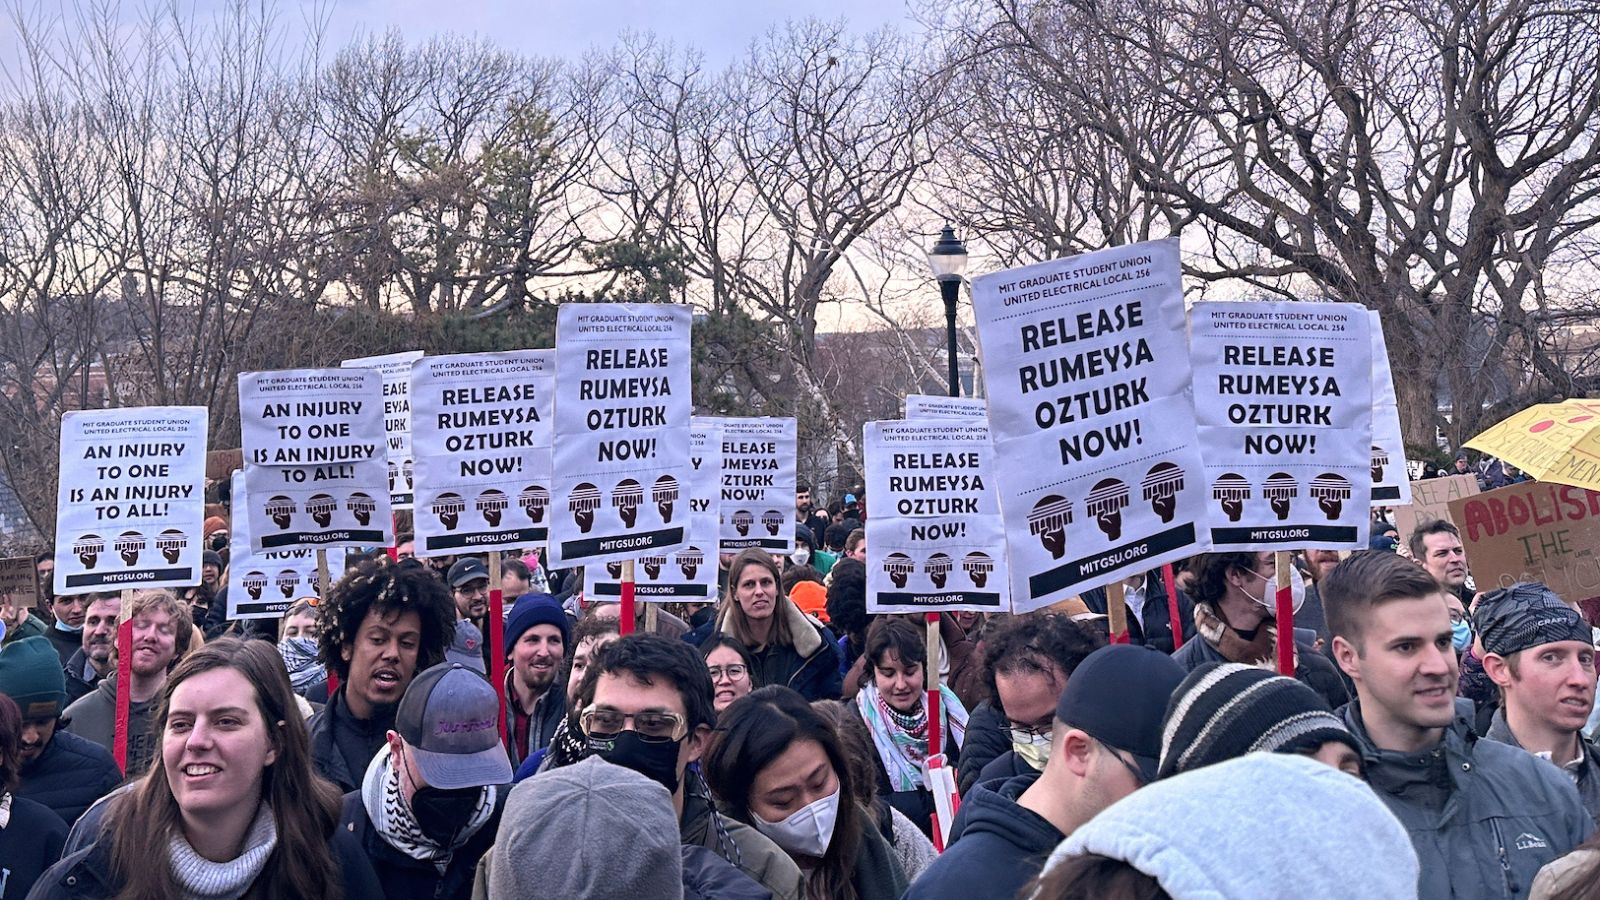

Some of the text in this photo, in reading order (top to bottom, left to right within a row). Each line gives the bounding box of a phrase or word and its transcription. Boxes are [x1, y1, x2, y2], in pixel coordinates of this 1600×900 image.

[999, 256, 1151, 294] MIT GRADUATE STUDENT UNION
[1003, 268, 1150, 307] UNITED ELECTRICAL LOCAL 256
[1211, 311, 1348, 322] MIT GRADUATE STUDENT UNION
[578, 325, 604, 333] UNITED
[1021, 300, 1144, 353] RELEASE
[1214, 321, 1345, 332] UNITED ELECTRICAL LOCAL 256
[444, 361, 483, 370] GRADUATE
[484, 359, 517, 367] STUDENT
[586, 348, 669, 370] RELEASE
[1224, 345, 1335, 367] RELEASE
[432, 370, 460, 378] UNITED
[461, 367, 504, 376] ELECTRICAL
[1019, 336, 1154, 394] RUMEYSA
[383, 382, 407, 396] EASE
[580, 376, 671, 400] RUMEYSA
[1219, 374, 1341, 397] RUMEYSA
[442, 385, 535, 405] RELEASE
[1035, 376, 1150, 429] OZTURK
[262, 401, 363, 419] AN INJURY
[384, 400, 410, 414] EYSA
[1228, 403, 1332, 426] OZTURK
[386, 418, 406, 432] URK
[437, 406, 540, 429] RUMEYSA
[586, 406, 667, 431] OZTURK
[278, 423, 350, 440] TO ONE
[389, 437, 404, 450] W!
[445, 430, 533, 452] OZTURK
[722, 442, 776, 453] ELEASE
[1058, 419, 1143, 466] NOW!
[1245, 434, 1316, 454] NOW!
[83, 443, 185, 459] AN INJURY
[253, 444, 375, 463] IS AN INJURY
[598, 438, 656, 462] NOW!
[460, 457, 522, 477] NOW!
[722, 458, 779, 470] UMEYSA
[893, 452, 979, 469] RELEASE
[97, 464, 169, 479] TO ONE
[282, 467, 354, 483] TO ALL!
[722, 474, 774, 486] ZTURK
[890, 475, 985, 492] RUMEYSA
[70, 484, 193, 503] IS AN INJURY
[722, 489, 765, 501] NOW!
[1410, 480, 1446, 507] REE
[95, 504, 169, 520] TO ALL!
[897, 498, 978, 515] OZTURK
[299, 532, 349, 542] MITGSU.ORG
[465, 532, 519, 544] MITGSU.ORG
[911, 522, 966, 541] NOW!
[1250, 528, 1309, 540] MITGSU.ORG
[600, 535, 652, 552] MITGSU.ORG
[1517, 529, 1573, 563] THE
[1079, 543, 1148, 576] MITGSU.ORG
[102, 572, 155, 582] MITGSU.ORG
[913, 594, 964, 604] MITGSU.ORG
[1537, 617, 1567, 626] CRAFT
